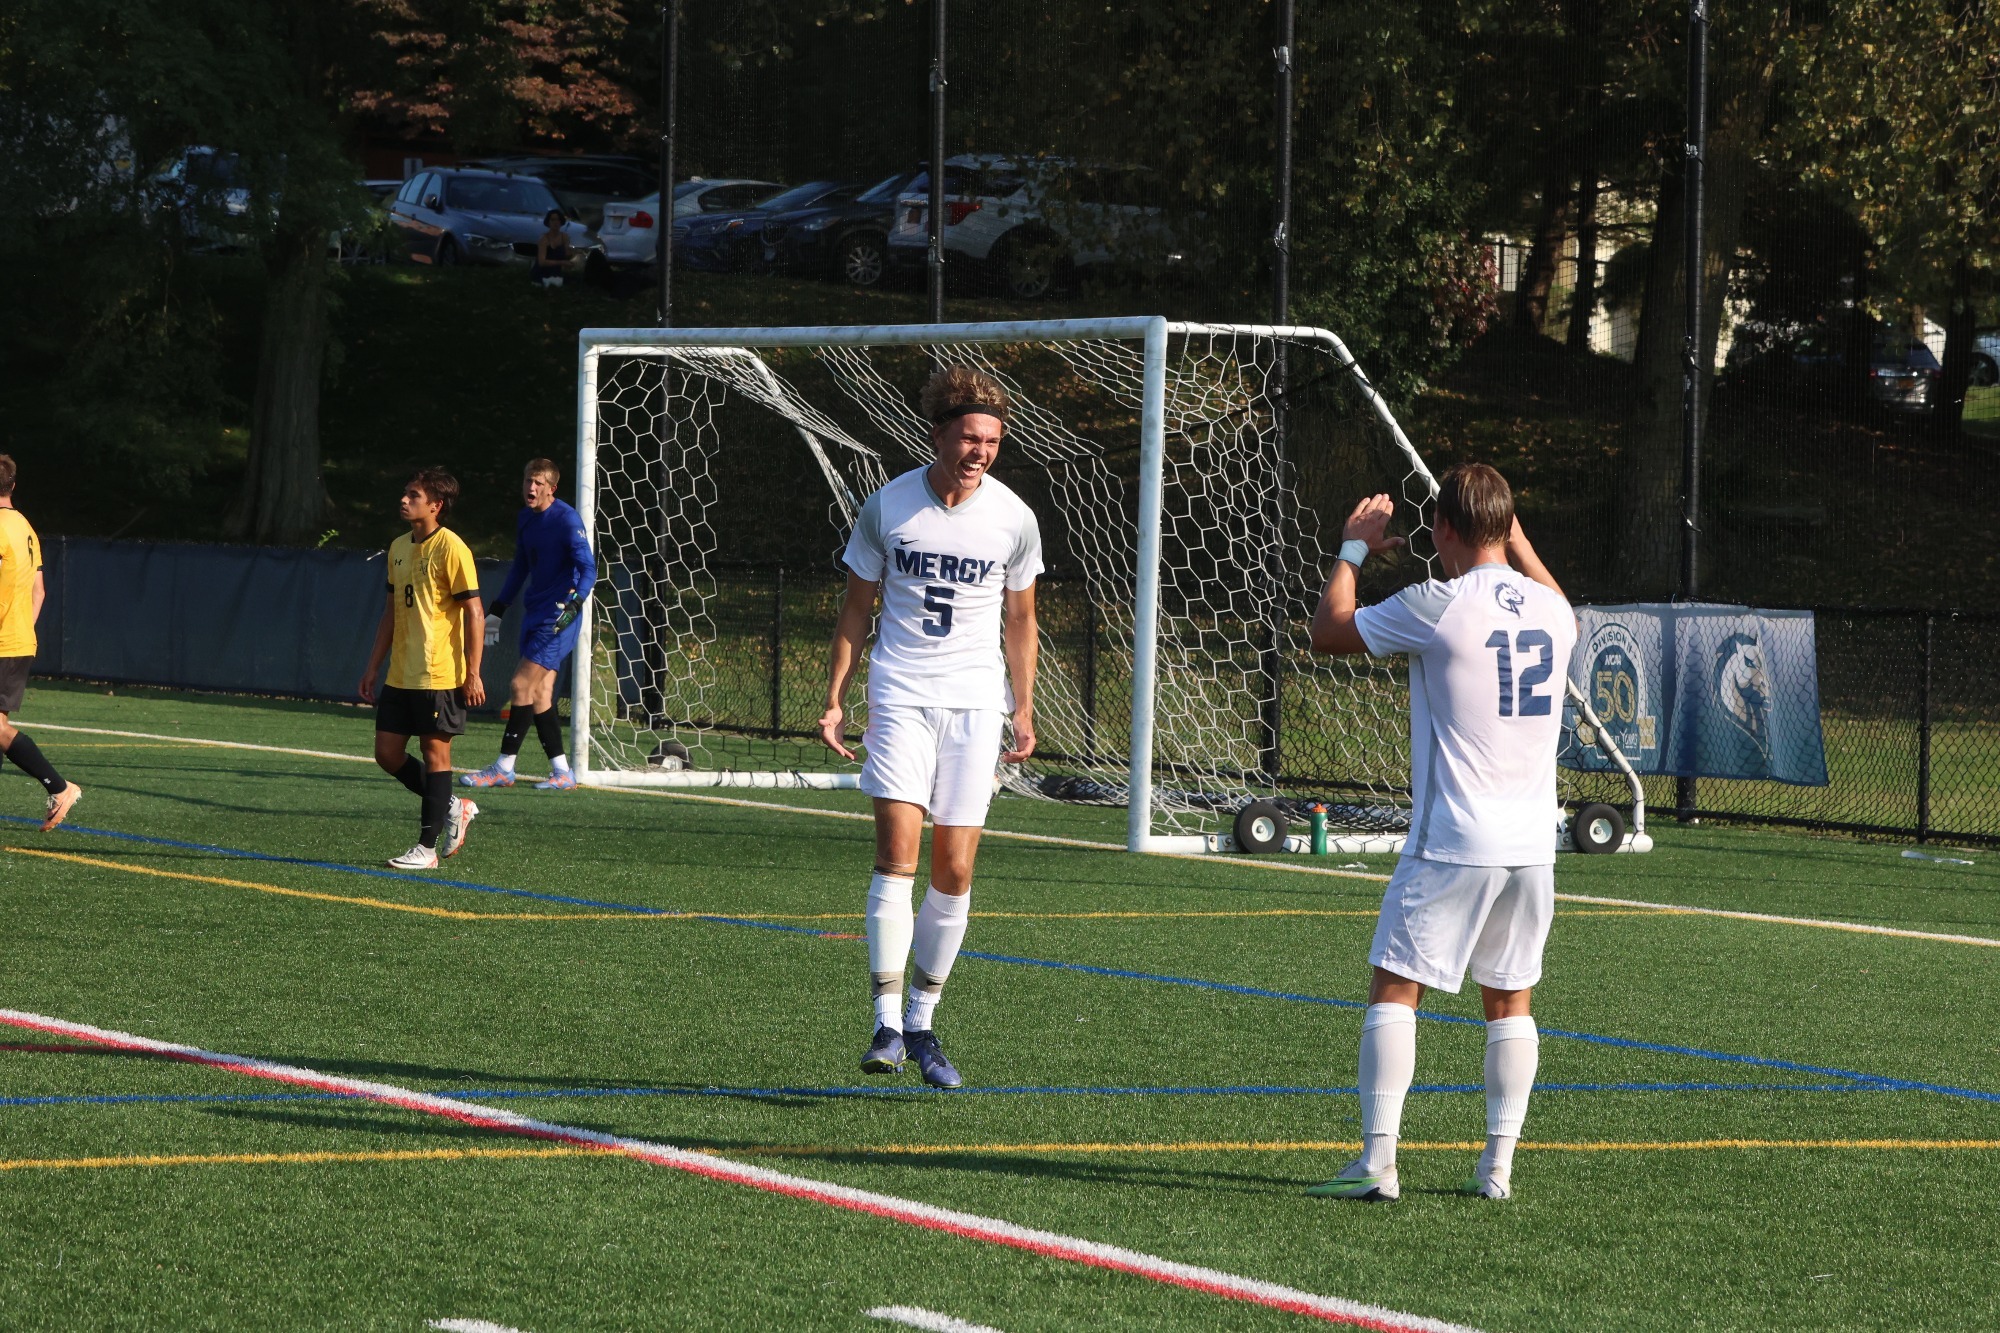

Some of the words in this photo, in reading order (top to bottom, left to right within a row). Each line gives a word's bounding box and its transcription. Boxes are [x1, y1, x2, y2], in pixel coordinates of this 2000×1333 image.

[27, 534, 34, 567] 6
[894, 548, 995, 584] MERCY
[404, 584, 414, 608] 8
[922, 585, 955, 637] 5
[1592, 631, 1627, 653] DIVISION
[1485, 629, 1553, 716] 12
[1596, 670, 1635, 723] 50
